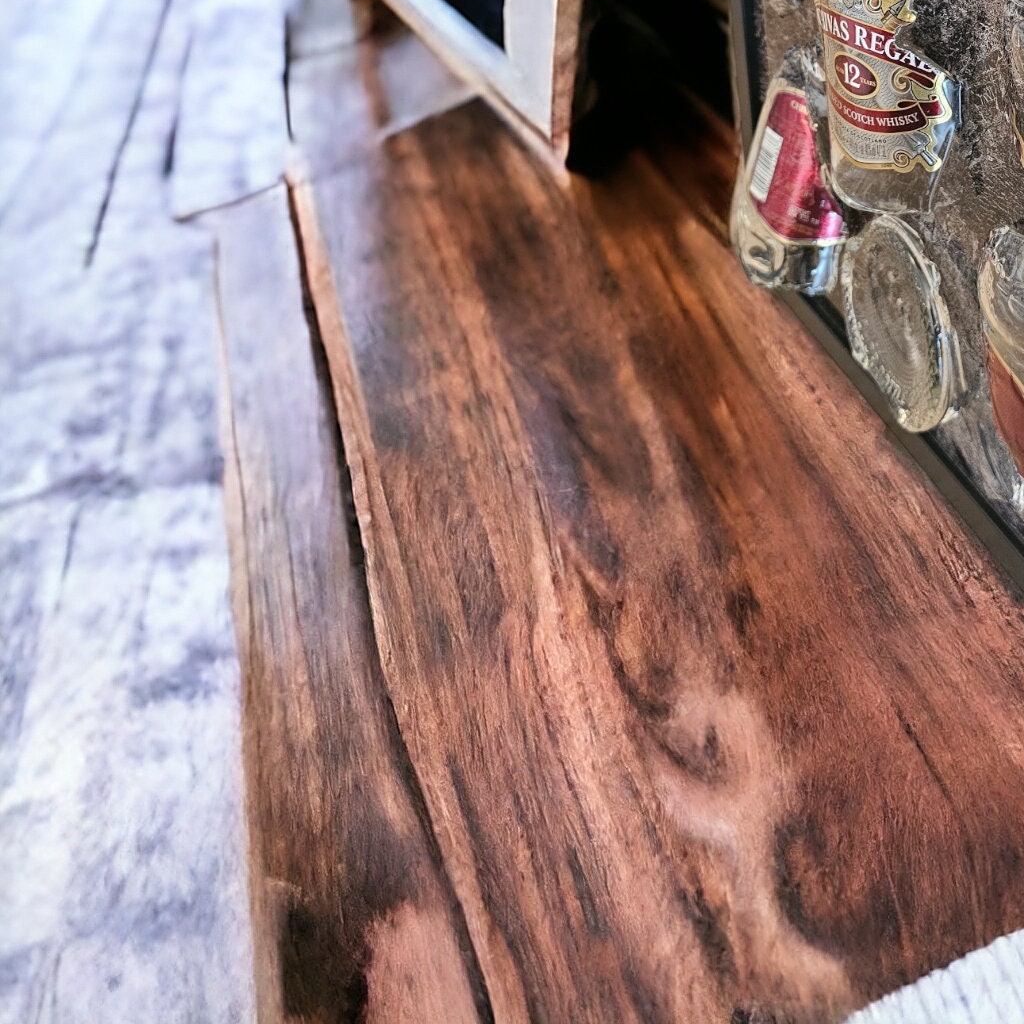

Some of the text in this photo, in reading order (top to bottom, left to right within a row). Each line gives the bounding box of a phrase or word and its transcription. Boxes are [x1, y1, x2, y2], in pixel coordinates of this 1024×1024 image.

[843, 61, 862, 89] 12
[843, 104, 875, 126] SCOTCH
[875, 111, 920, 127] WHISKY
